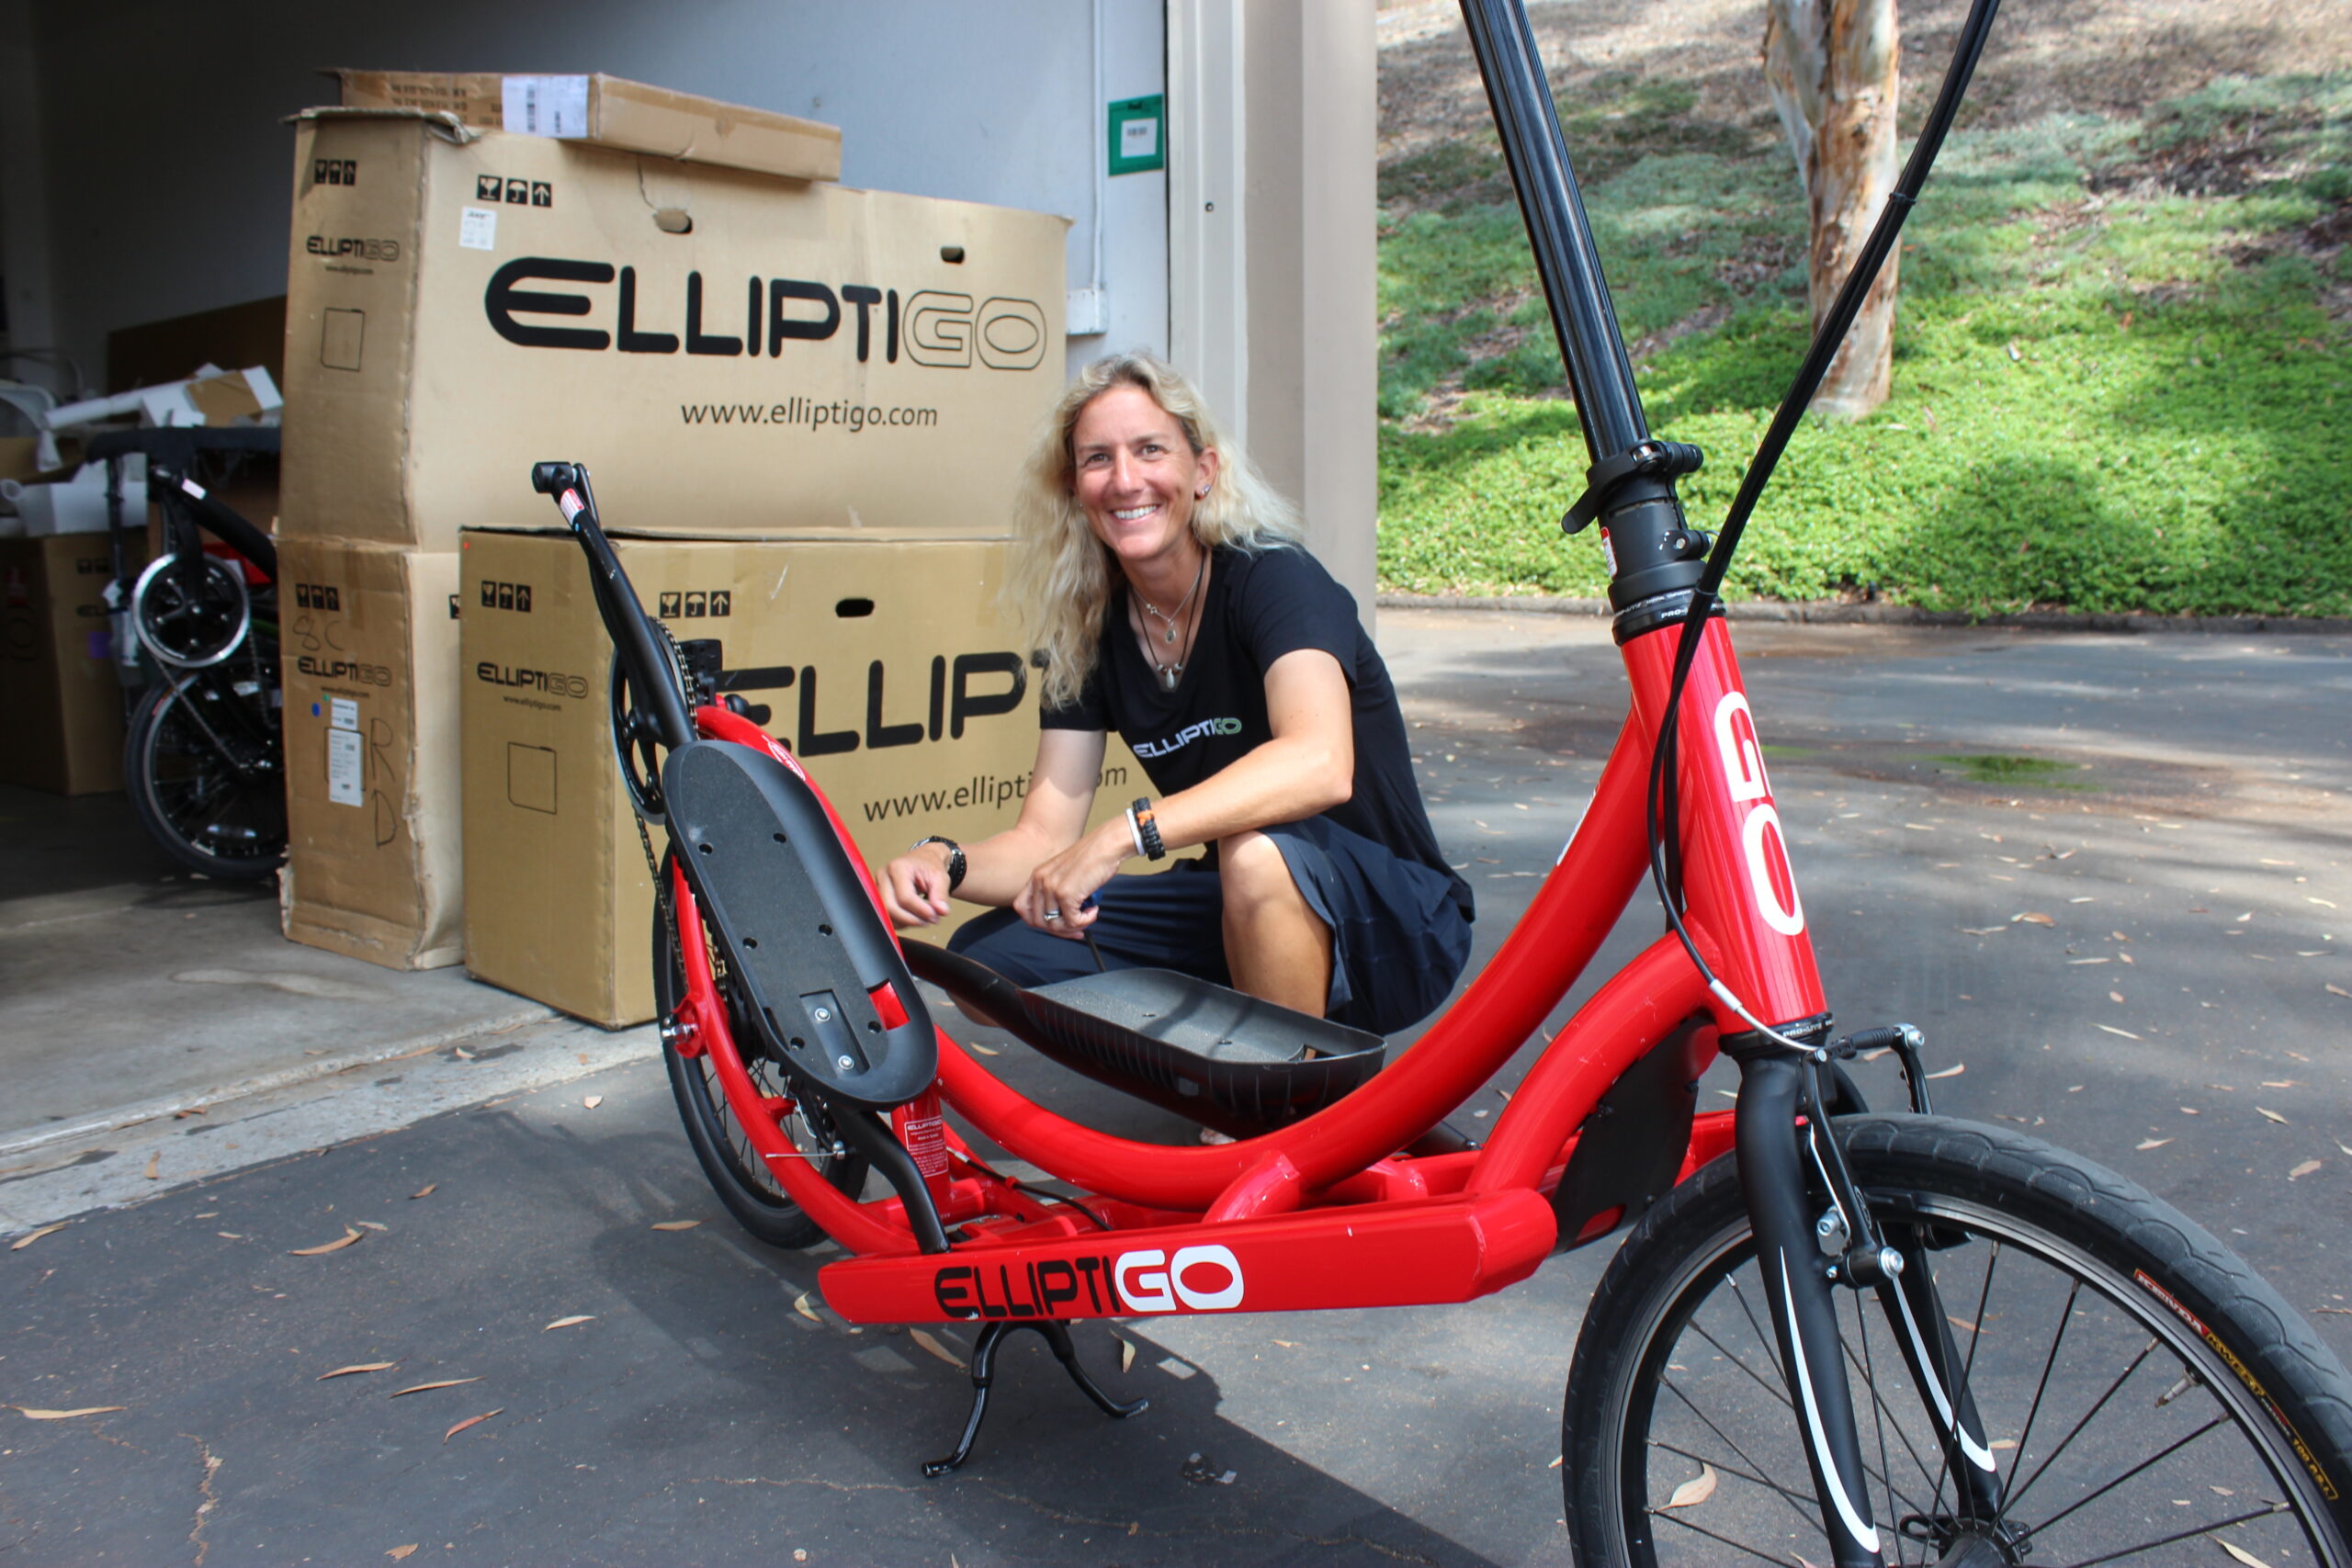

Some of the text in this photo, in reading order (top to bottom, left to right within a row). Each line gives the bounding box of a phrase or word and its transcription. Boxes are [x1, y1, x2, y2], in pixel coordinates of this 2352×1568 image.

[306, 235, 400, 262] ELLIPTIGO
[484, 256, 1047, 371] ELLIPTIGO
[681, 397, 939, 433] www.elliptigo.com
[298, 655, 391, 687] ELLIPTIGO
[477, 660, 589, 700] ELLIPTIGO
[718, 651, 1049, 757] ELLIP
[1133, 717, 1242, 758] ELLIPTIGO
[1714, 691, 1804, 936] GO
[934, 1244, 1244, 1319] ELLIPTIGO
[2135, 1273, 2204, 1333] KENDA
